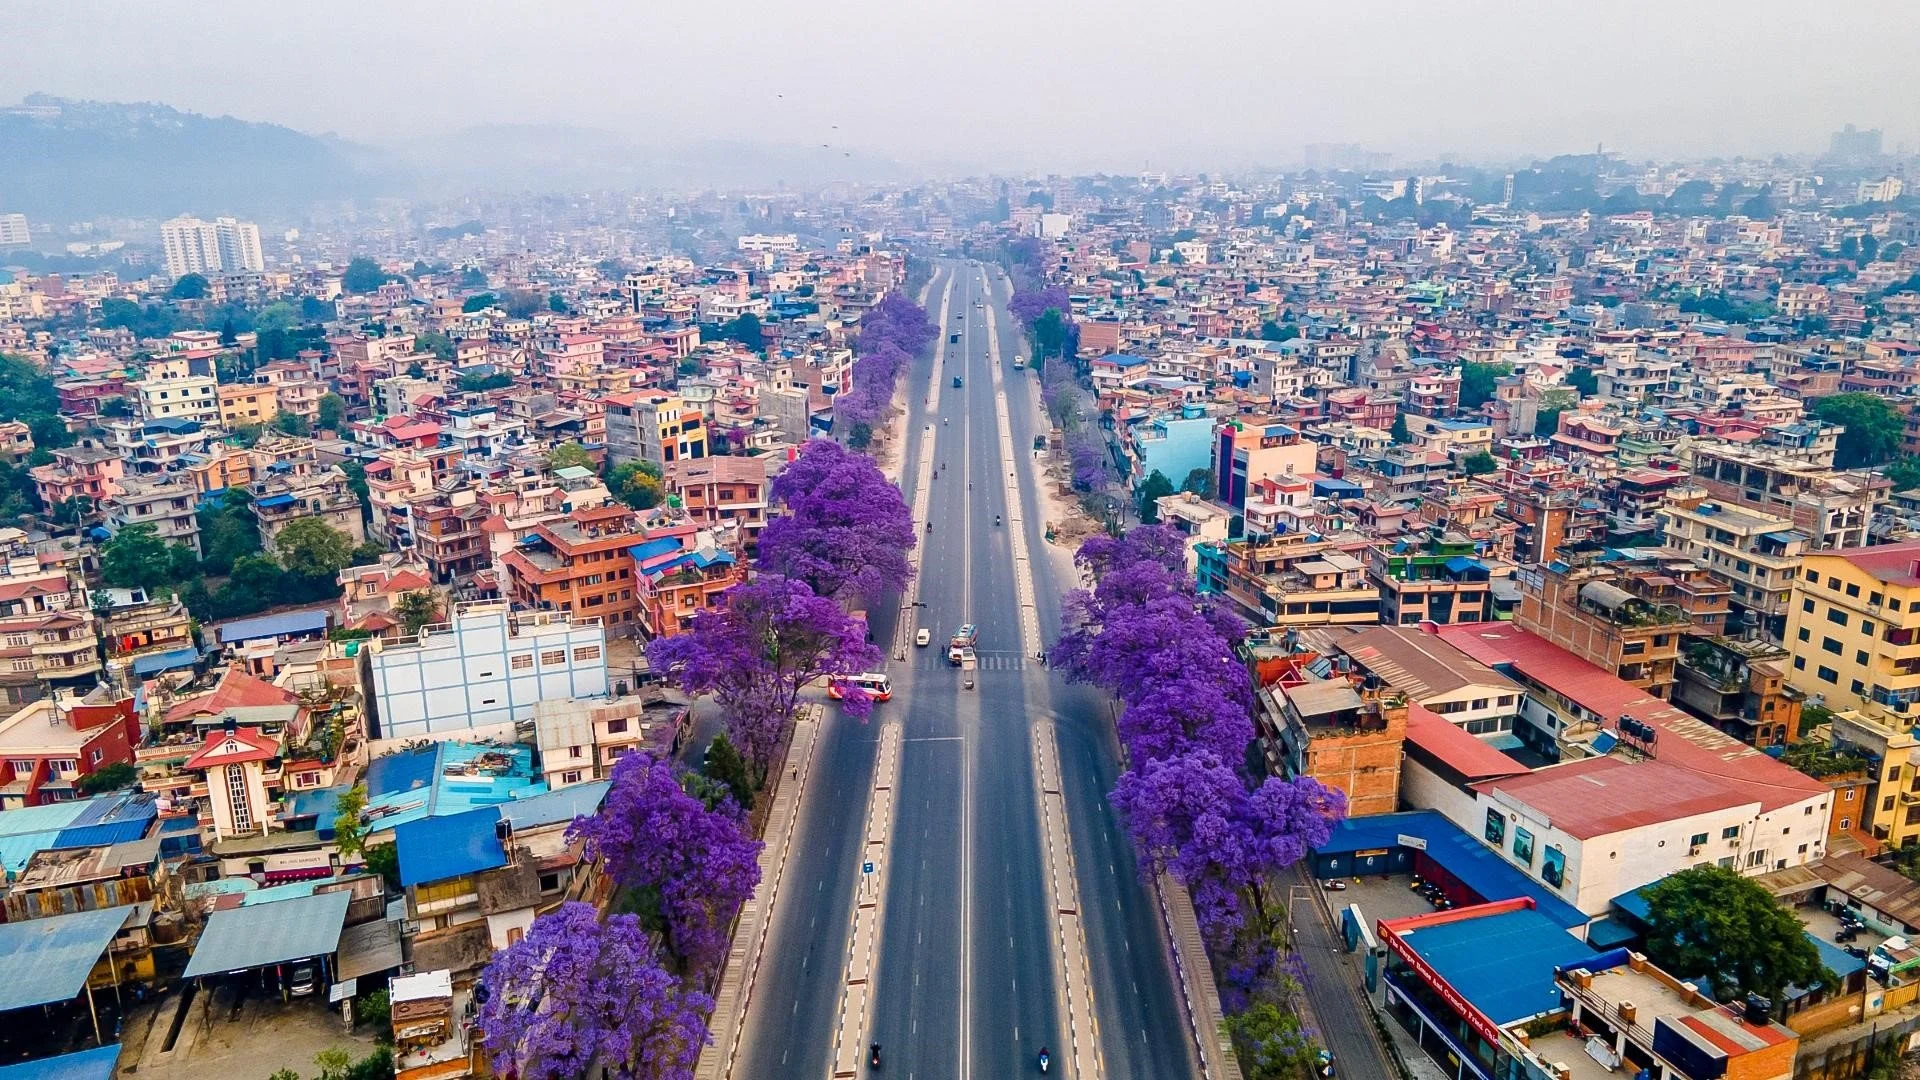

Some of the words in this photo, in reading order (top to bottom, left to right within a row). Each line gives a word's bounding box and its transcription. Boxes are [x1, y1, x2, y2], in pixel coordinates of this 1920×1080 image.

[1389, 936, 1398, 948] The
[1400, 946, 1415, 965] Burger
[1433, 978, 1443, 992] And
[1444, 989, 1467, 1015] Crunchy
[1468, 1011, 1484, 1031] Fried
